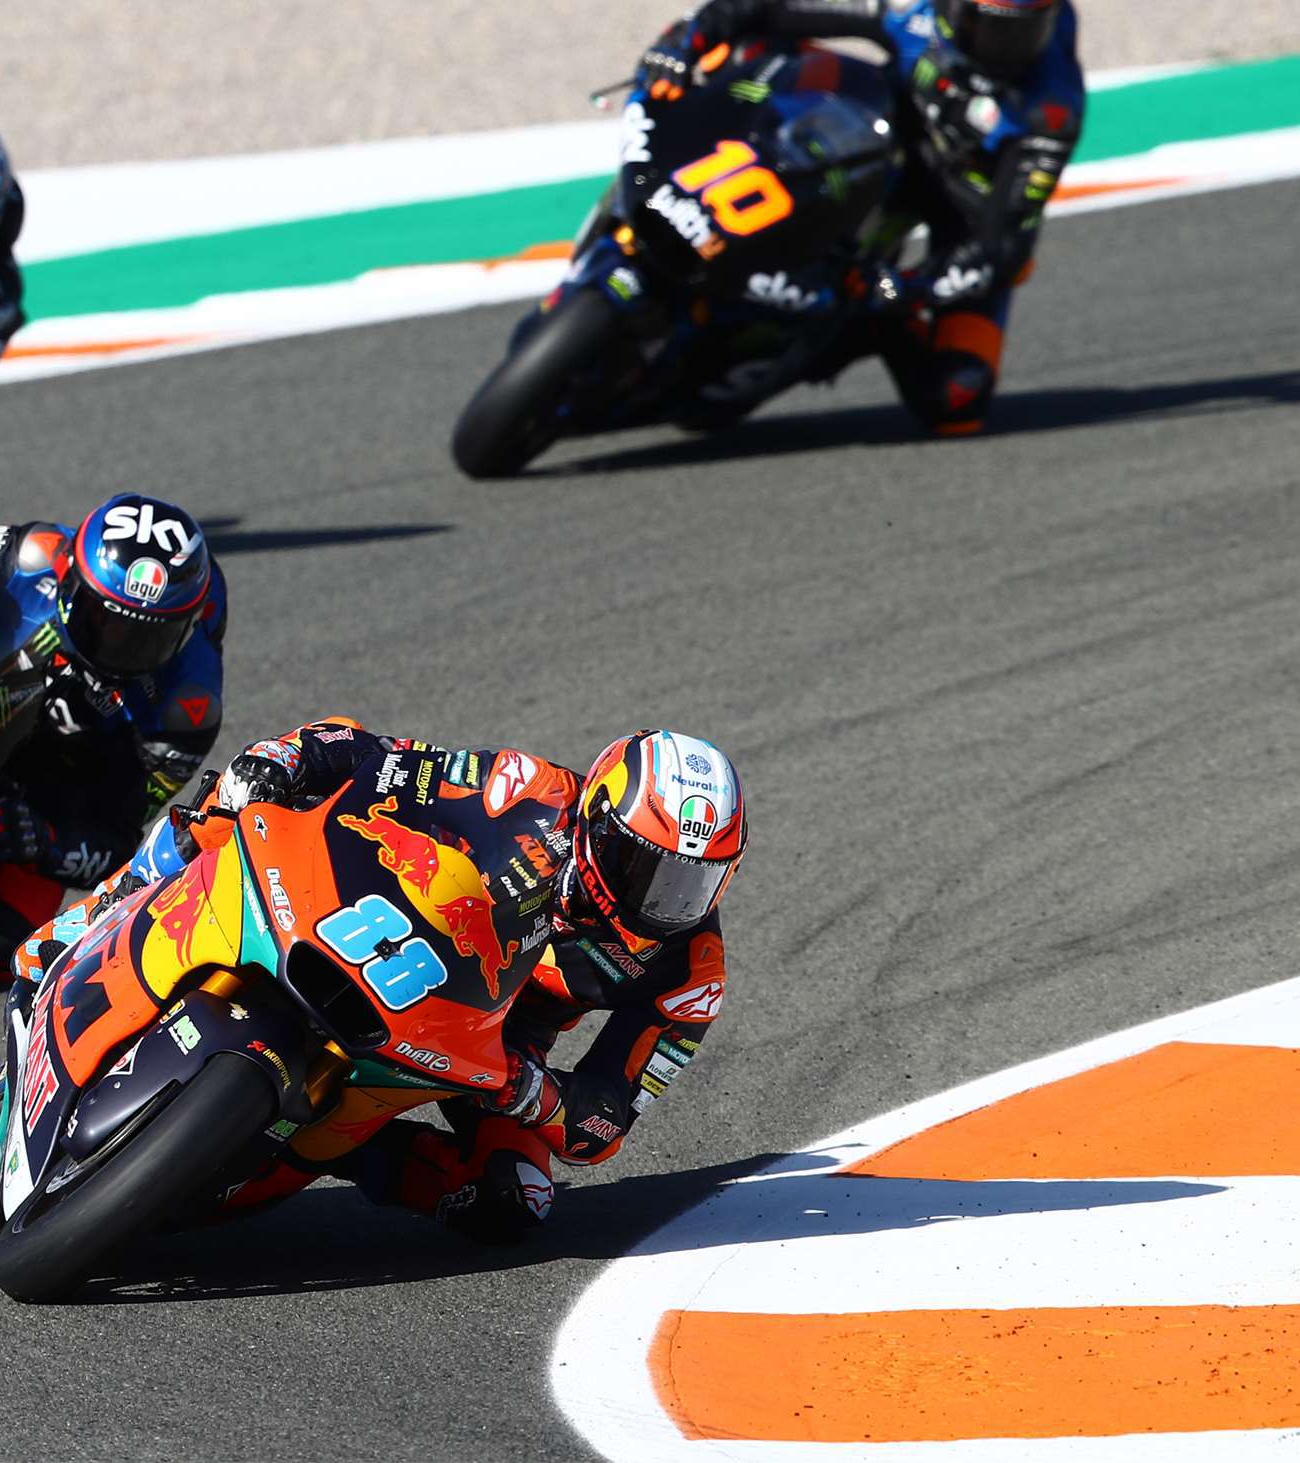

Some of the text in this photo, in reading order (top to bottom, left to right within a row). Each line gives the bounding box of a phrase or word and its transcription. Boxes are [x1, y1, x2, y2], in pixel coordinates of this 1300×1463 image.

[671, 139, 795, 237] 10
[102, 504, 204, 567] sky
[130, 580, 159, 598] agv
[681, 819, 713, 839] agv
[636, 837, 669, 858] GIVES
[674, 853, 697, 866] YOU
[314, 893, 448, 1012] 88
[588, 947, 622, 983] MOTOREX
[598, 942, 646, 980] AVANT
[576, 1114, 622, 1143] AVANT
